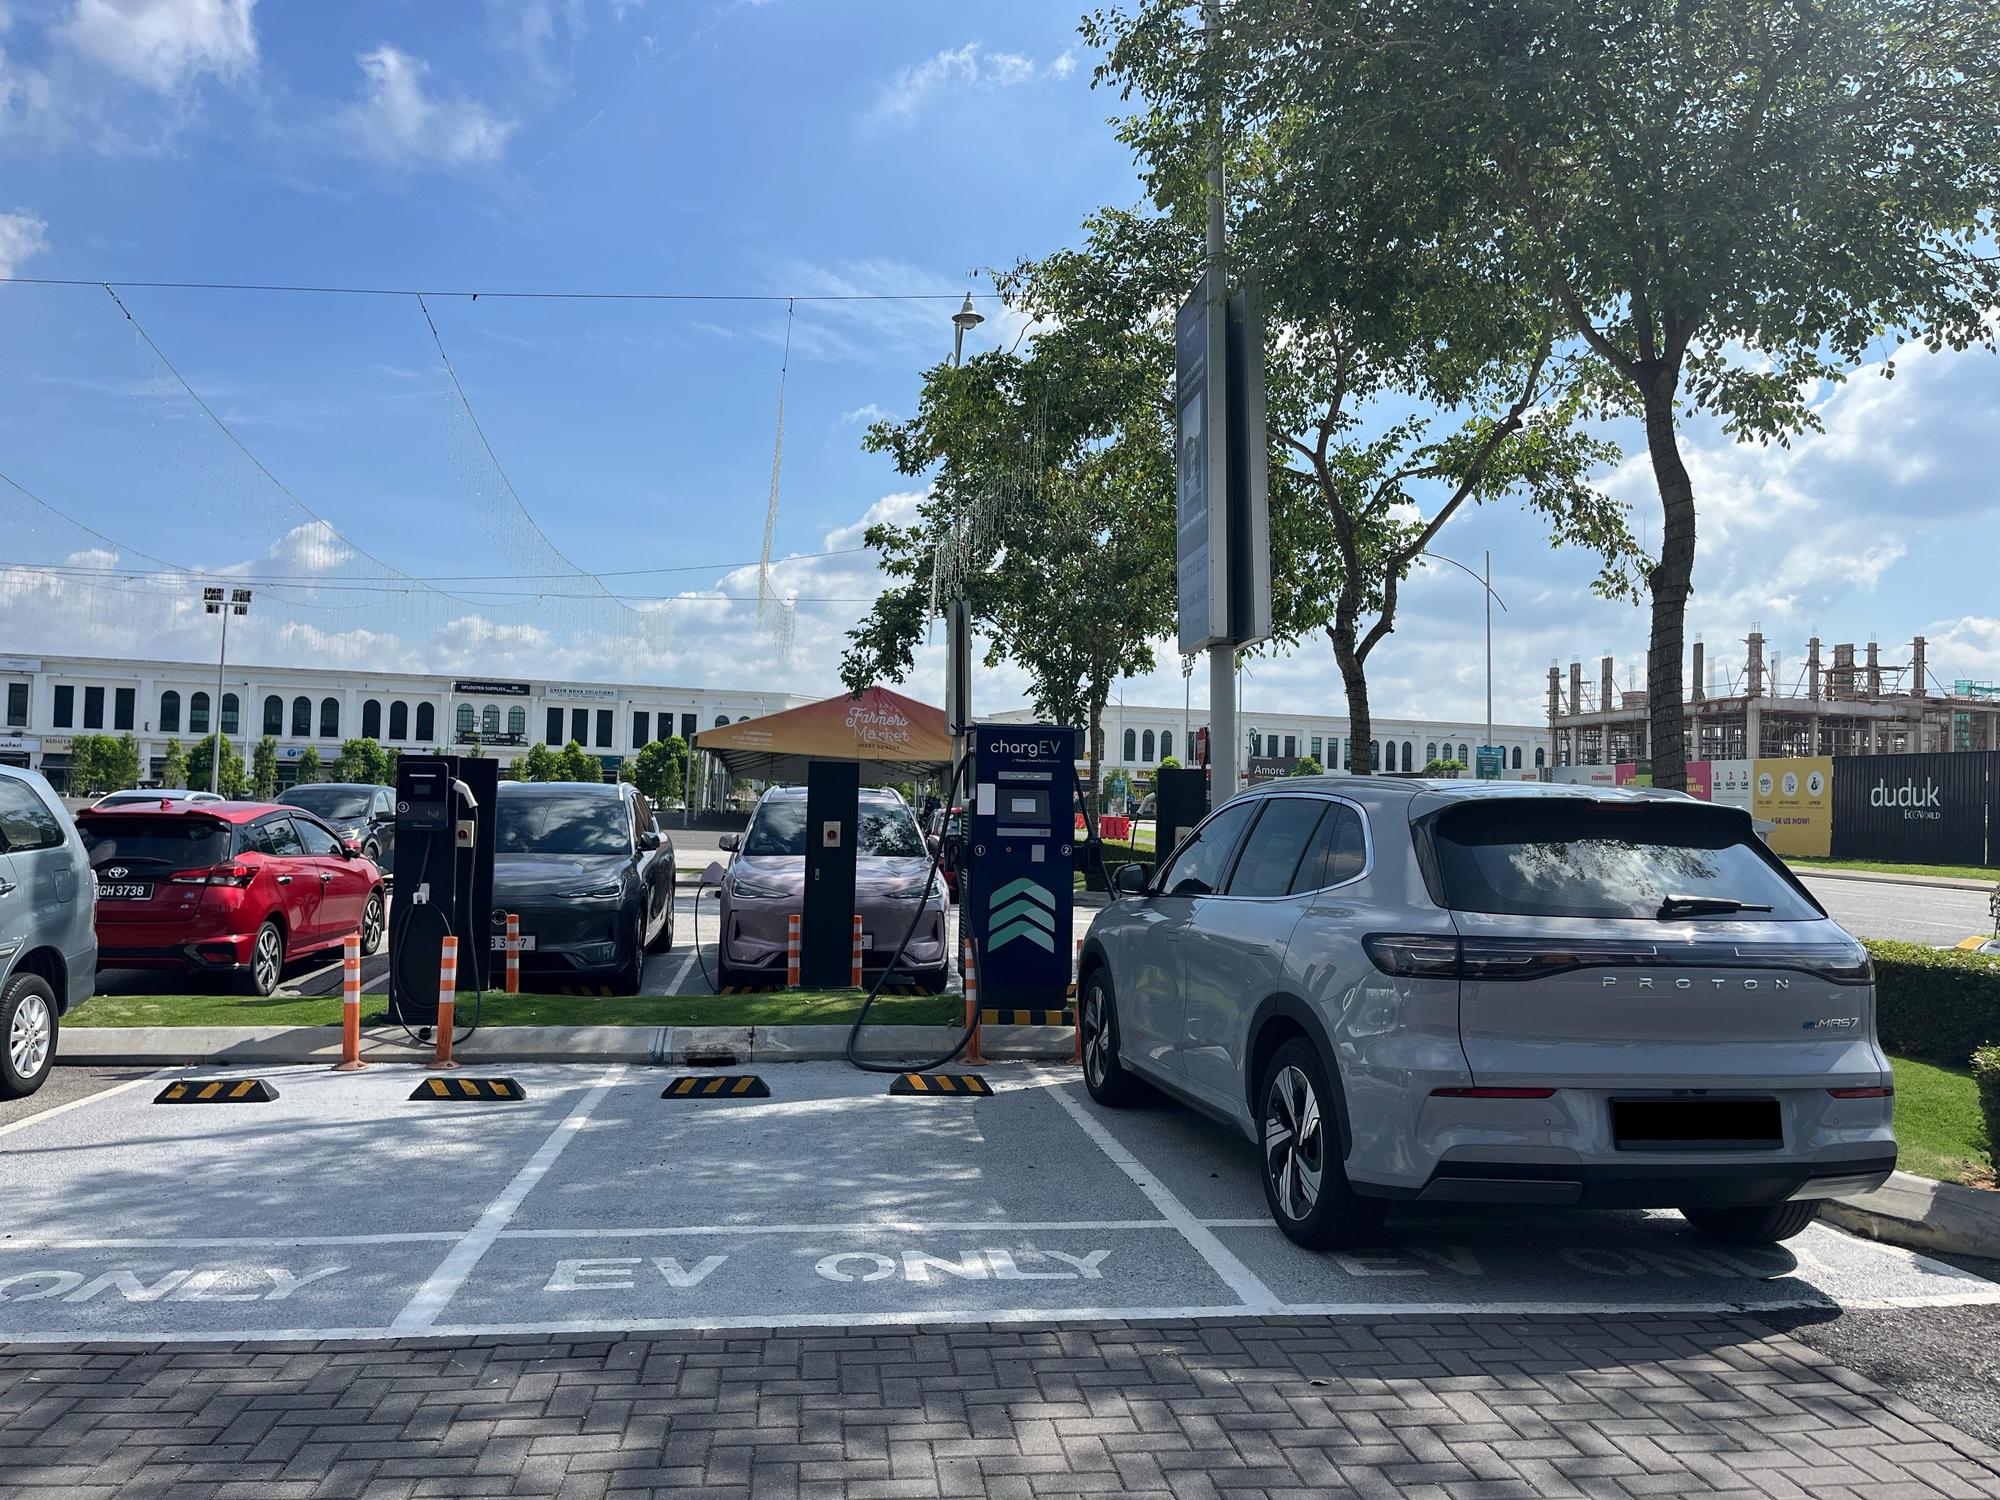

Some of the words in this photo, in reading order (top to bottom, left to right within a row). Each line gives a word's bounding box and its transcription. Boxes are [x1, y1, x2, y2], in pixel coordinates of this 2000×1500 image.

[846, 707, 911, 727] Farmers
[854, 726, 911, 743] Market
[990, 739, 1061, 757] chargEV
[1254, 765, 1285, 775] Amore
[1870, 776, 1941, 807] duduk
[1783, 817, 1791, 825] US
[1792, 817, 1810, 825] NOW!
[98, 885, 115, 896] GH
[115, 885, 145, 896] 3738
[1602, 976, 1789, 990] PROTON
[542, 1255, 730, 1292] EV
[815, 1250, 1111, 1282] ONLY
[1328, 1246, 1485, 1278] EV
[0, 1266, 350, 1302] ONLY
